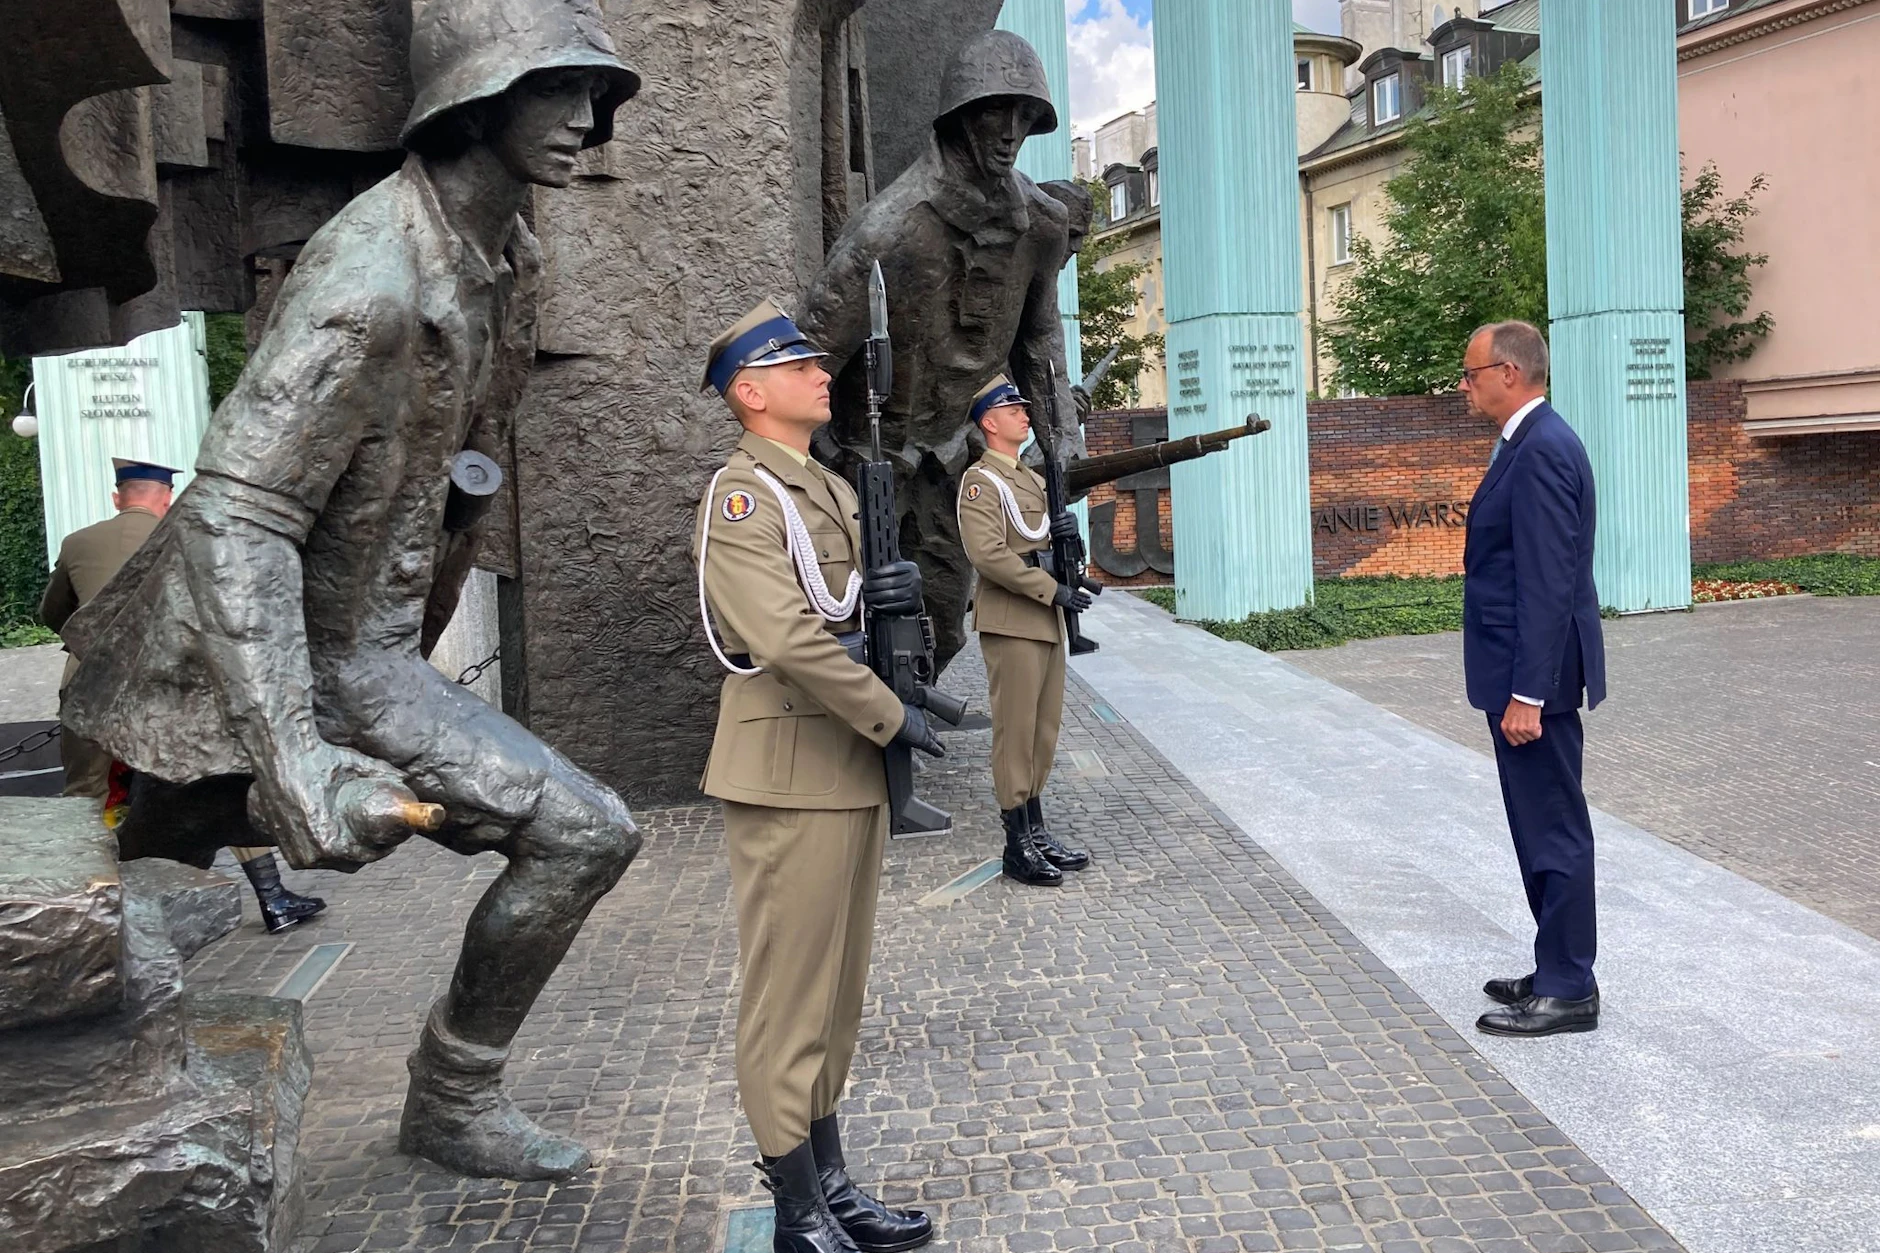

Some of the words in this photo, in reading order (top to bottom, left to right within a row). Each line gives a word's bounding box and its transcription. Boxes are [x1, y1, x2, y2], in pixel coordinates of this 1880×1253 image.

[66, 358, 159, 368] ZGRUPOWANIE
[92, 394, 142, 404] PLUTON
[80, 407, 152, 419] SŁOWAKÓW
